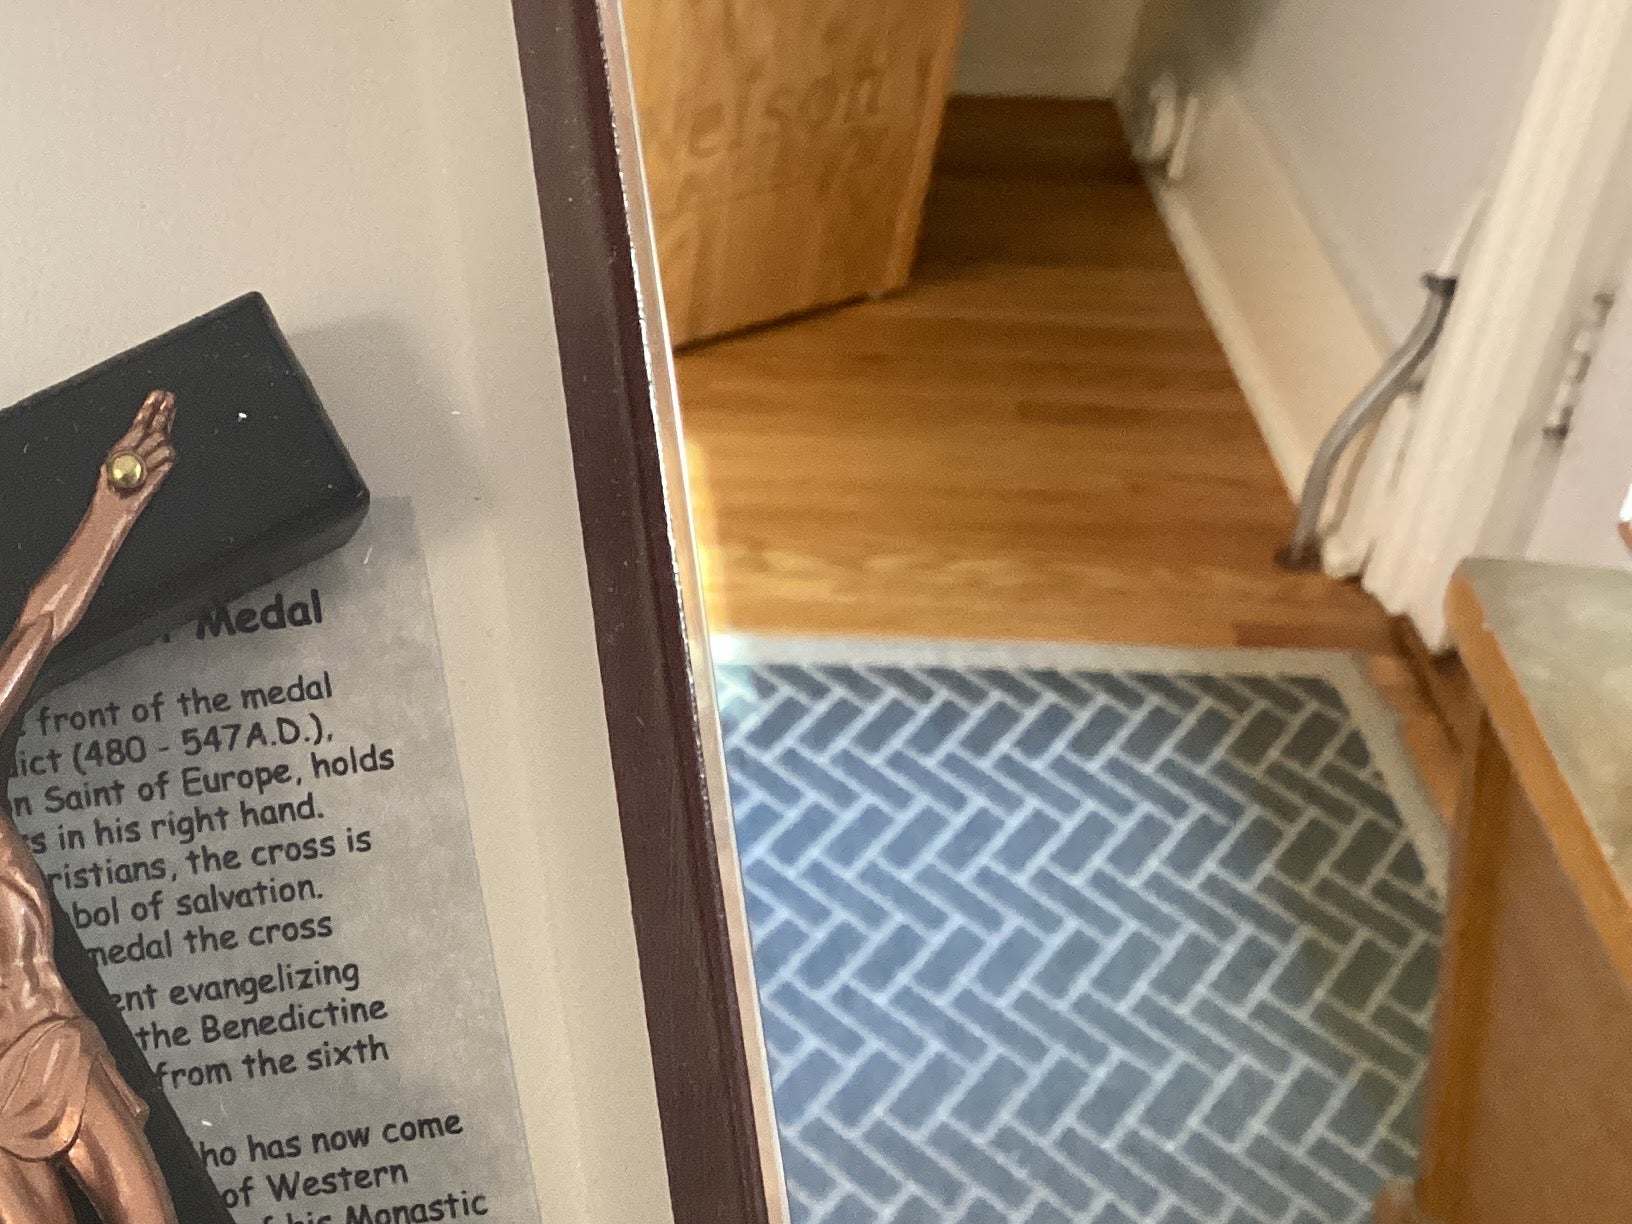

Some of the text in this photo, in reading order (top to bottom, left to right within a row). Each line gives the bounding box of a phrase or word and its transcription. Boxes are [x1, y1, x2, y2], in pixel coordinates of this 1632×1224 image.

[197, 589, 323, 639] Medal
[38, 671, 332, 736] front of the medal
[45, 780, 125, 813] Saint
[138, 771, 169, 802] of
[182, 764, 302, 796] Europe,
[311, 745, 395, 779] holds
[73, 736, 146, 775] (480
[59, 825, 85, 850] in
[94, 818, 141, 846] his
[151, 808, 229, 844] right
[240, 792, 324, 827] hand.
[186, 848, 241, 876] the
[251, 835, 336, 868] cross
[346, 827, 372, 853] is
[131, 890, 163, 921] of
[177, 878, 323, 916] salvation.
[184, 926, 239, 955] the
[249, 916, 334, 949] cross
[169, 961, 361, 1006] evangelizing
[135, 998, 388, 1050] the Benedictine
[155, 1034, 390, 1090] from the sixth
[247, 1135, 301, 1162] has
[312, 1126, 370, 1154] now
[382, 1114, 464, 1143] come
[222, 1164, 408, 1209] of Western
